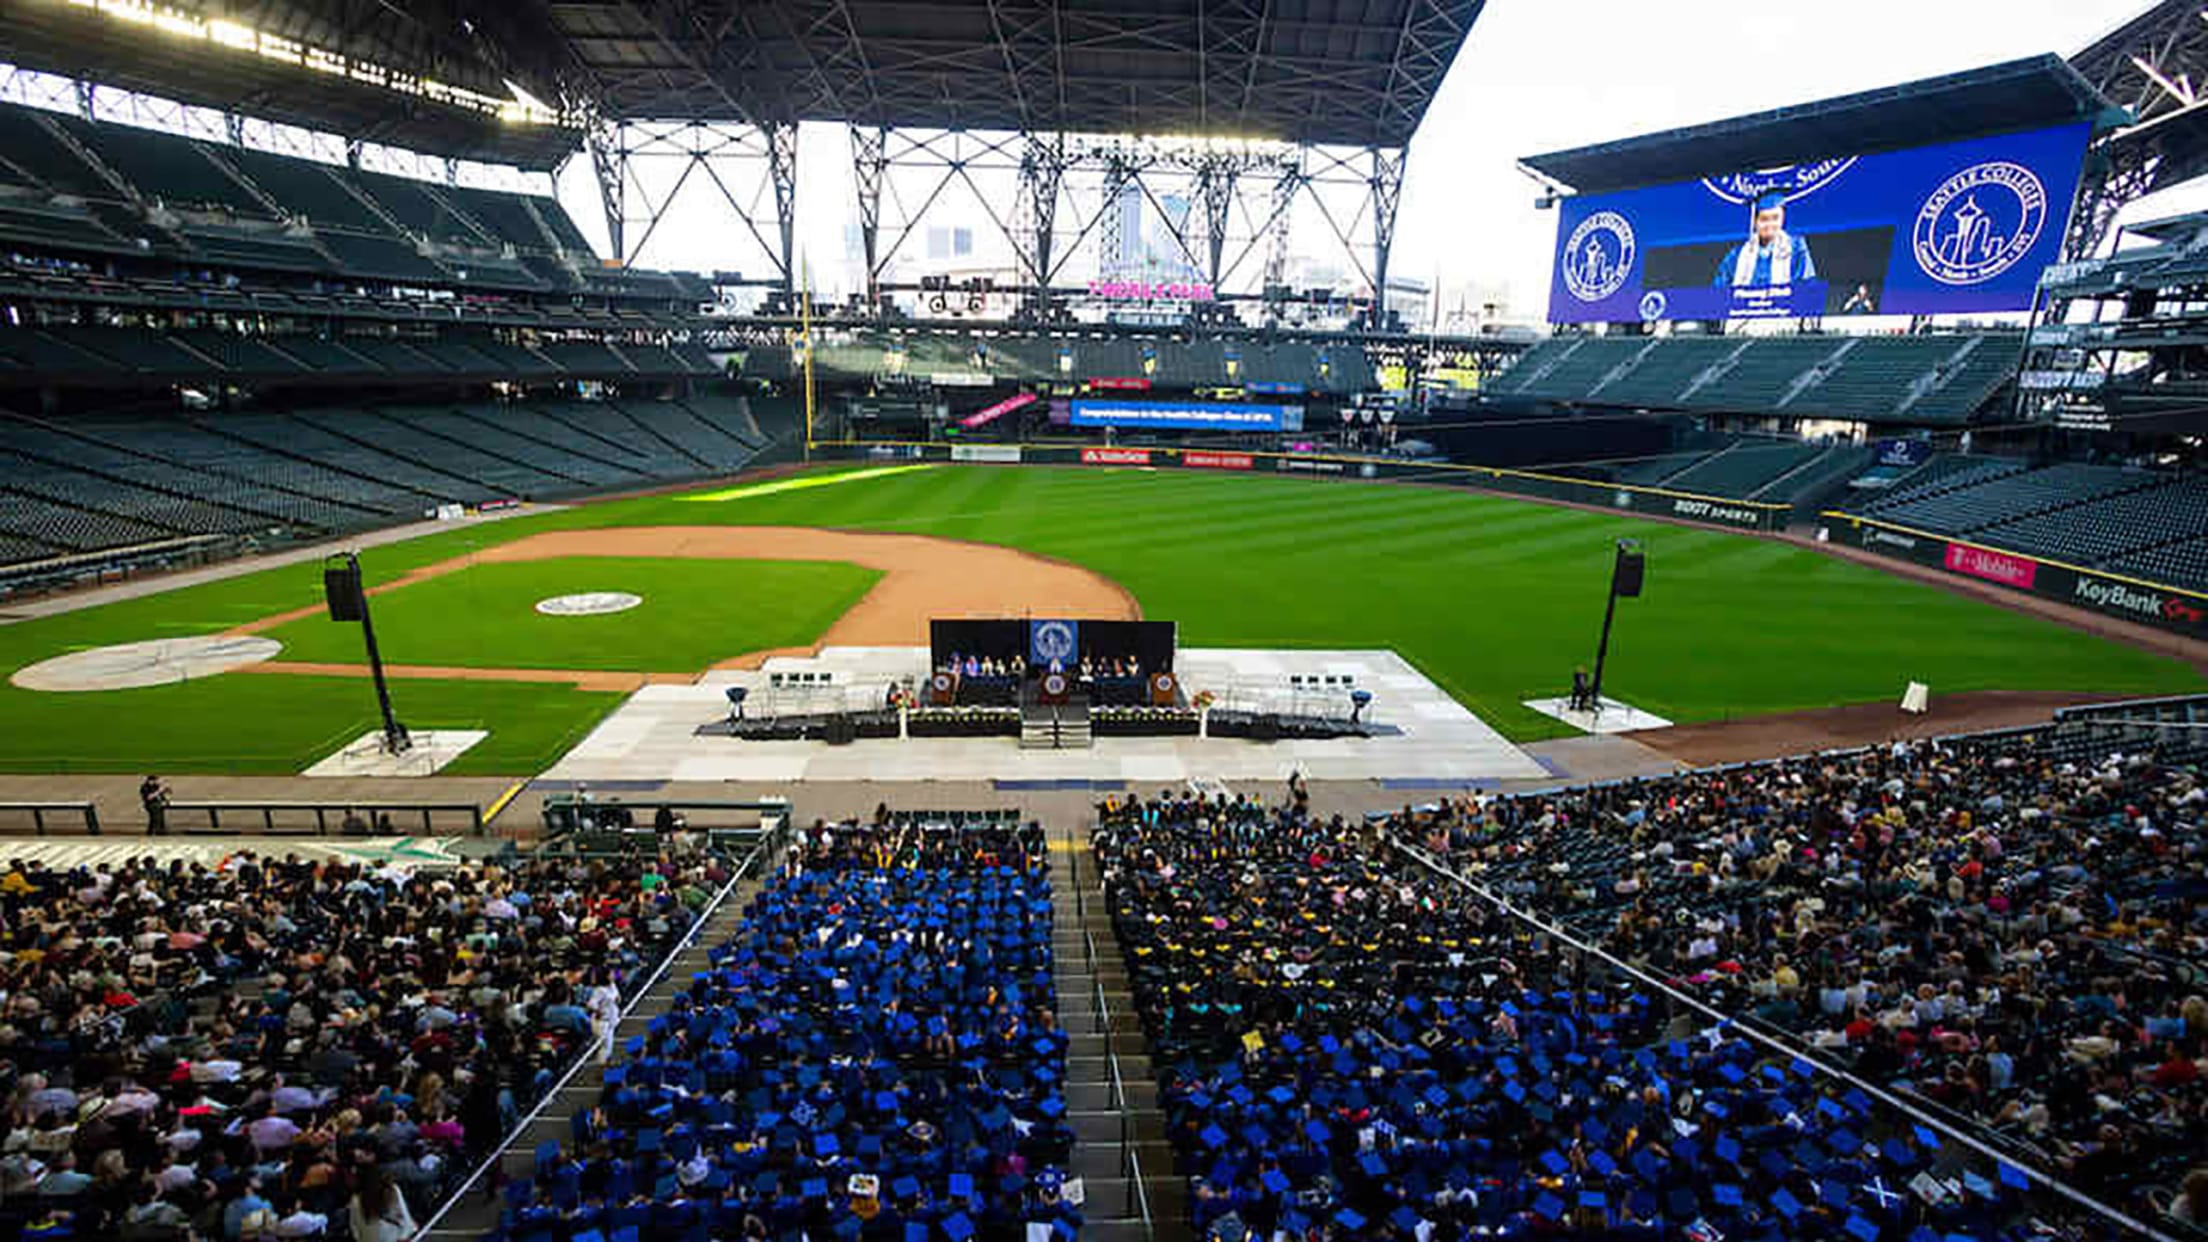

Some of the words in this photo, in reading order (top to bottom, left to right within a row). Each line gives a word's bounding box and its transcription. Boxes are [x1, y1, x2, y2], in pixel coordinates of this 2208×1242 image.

[1728, 172, 1780, 197] Nor
[1796, 157, 1844, 188] Sou
[2076, 577, 2163, 615] KeyBank
